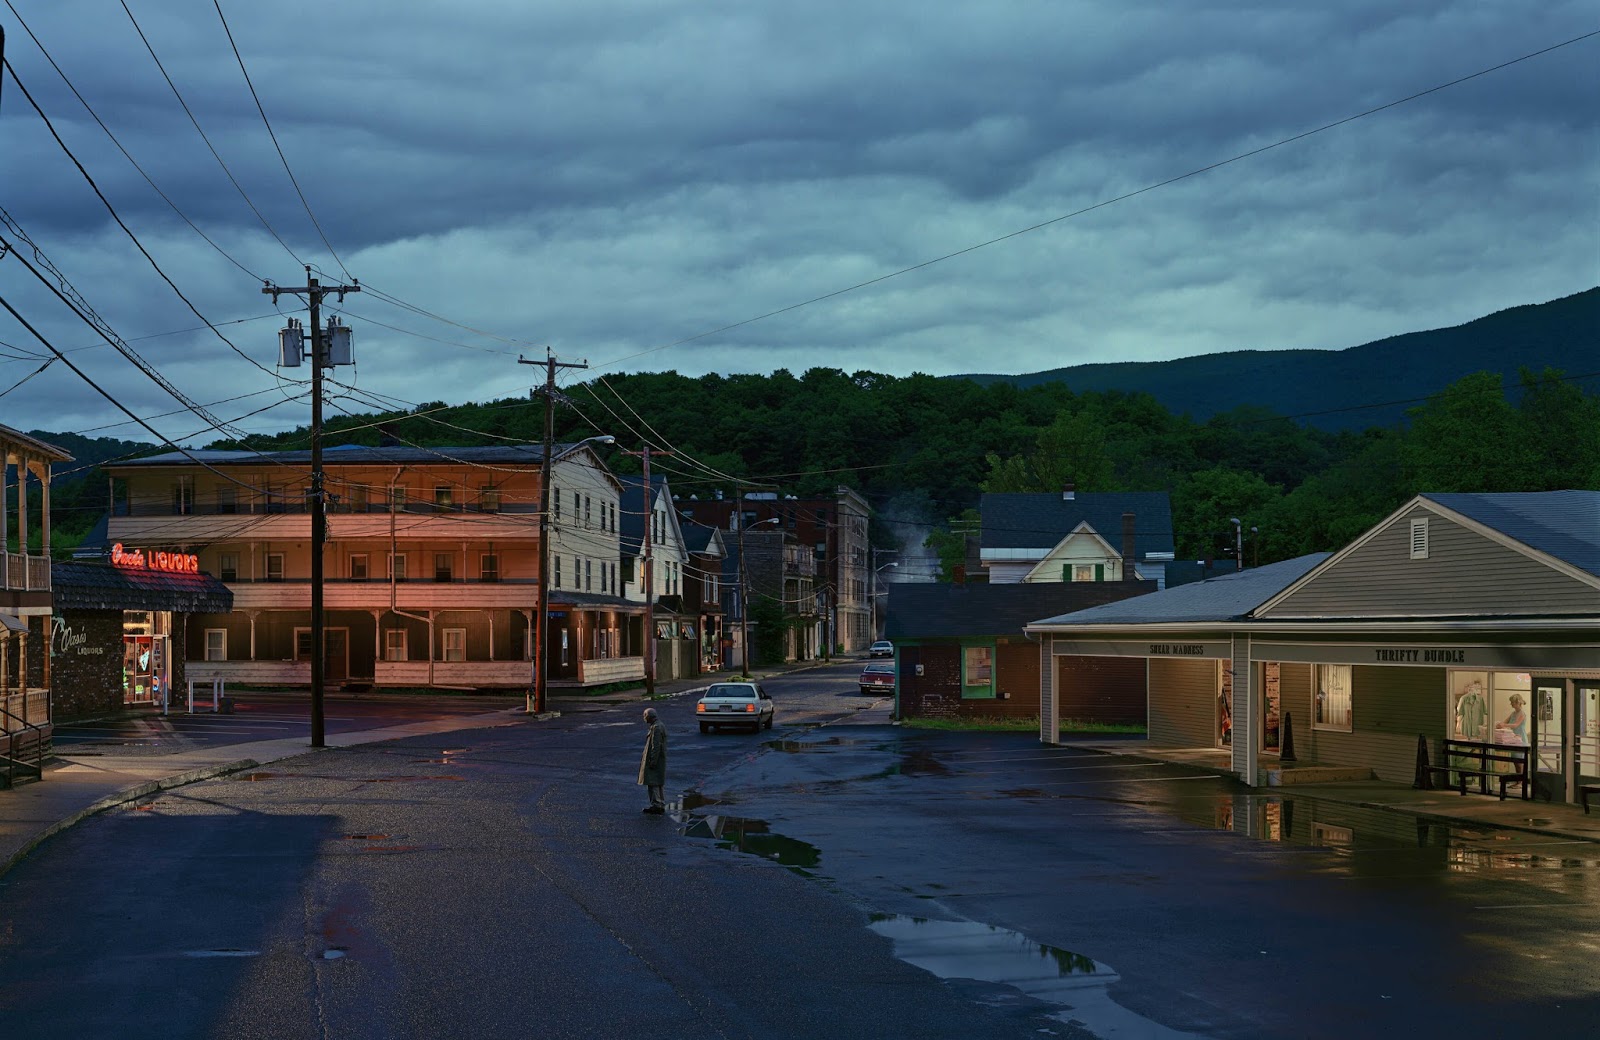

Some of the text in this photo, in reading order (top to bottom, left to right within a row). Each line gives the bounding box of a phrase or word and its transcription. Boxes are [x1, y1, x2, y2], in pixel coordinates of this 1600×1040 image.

[148, 551, 198, 571] LIQUORS
[61, 626, 87, 652] Oasis
[77, 647, 103, 656] LIQUORS
[1150, 644, 1204, 655] SHEAR MADNESS
[1376, 649, 1465, 663] THRIFTY BUNDLE
